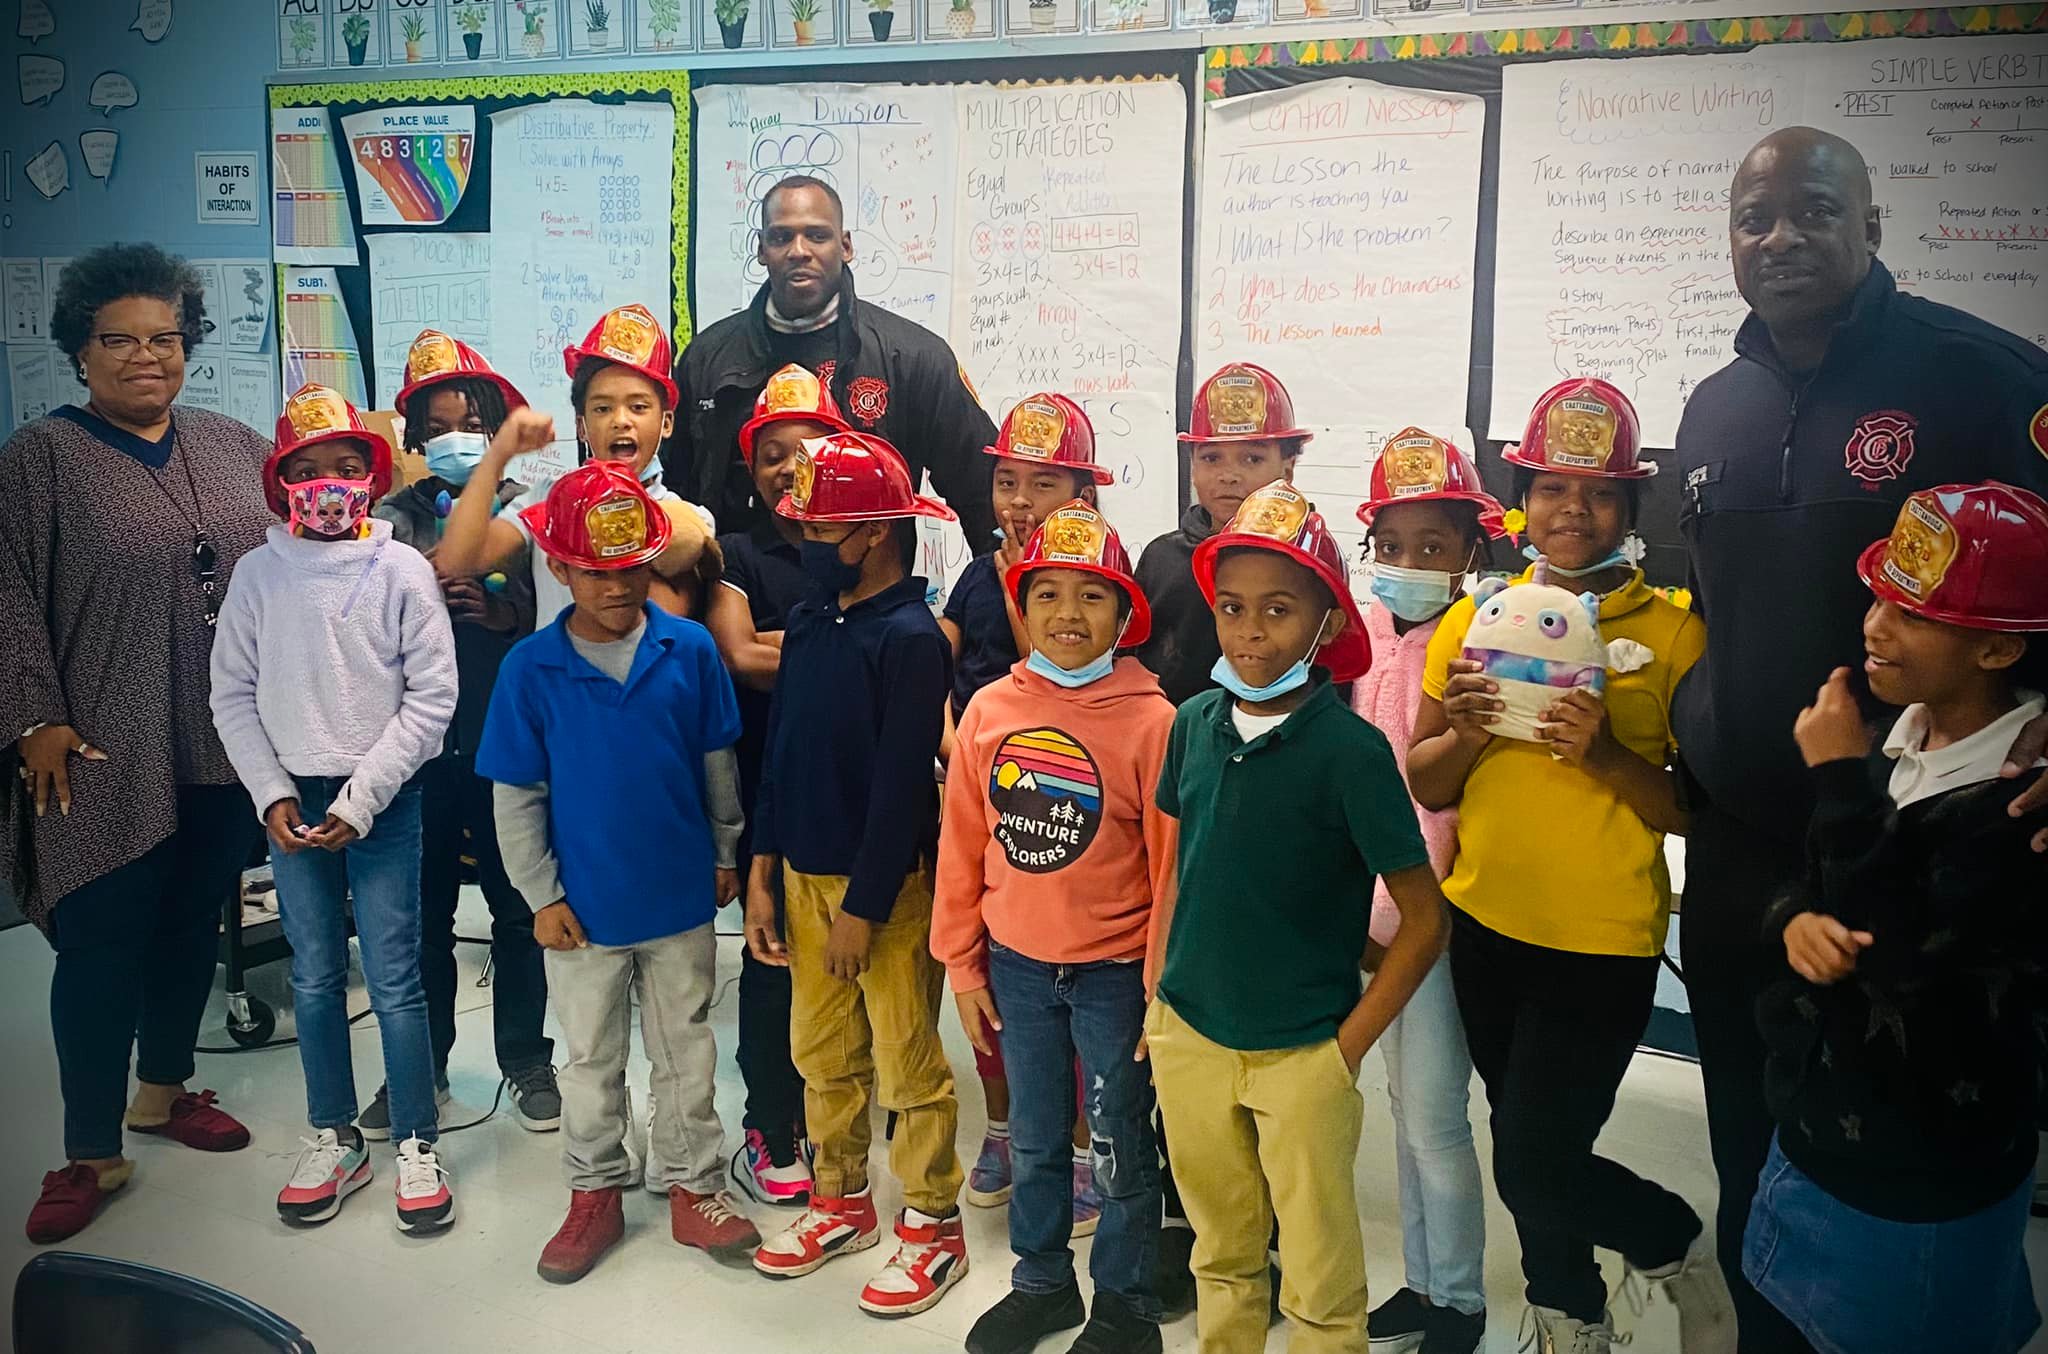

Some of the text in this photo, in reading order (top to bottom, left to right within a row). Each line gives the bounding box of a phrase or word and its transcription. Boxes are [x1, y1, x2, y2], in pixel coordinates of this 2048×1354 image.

[1872, 54, 2028, 84] SIMPLE VERB
[814, 95, 909, 122] Division
[966, 87, 1136, 131] MULTIPLICATION
[1577, 83, 1776, 126] Narrative Writing
[1845, 94, 1896, 113] PAST
[383, 115, 449, 127] PLACE VALUE
[750, 113, 782, 135] Array
[1249, 96, 1465, 139] Central Message
[989, 121, 1114, 160] STRATEGIES
[561, 150, 587, 168] with
[1219, 152, 1414, 187] The Lesson the
[1534, 155, 1566, 184] The
[1647, 159, 1673, 180] of
[1943, 161, 1957, 174] to
[1966, 162, 1998, 174] school
[205, 166, 249, 178] HABITS
[967, 165, 1007, 201] Equal
[219, 183, 235, 195] OF
[1645, 186, 1662, 206] to
[1673, 185, 1701, 206] tell
[1703, 190, 1715, 203] a
[207, 200, 251, 212] INTERACTION
[989, 194, 1042, 220] Groups
[1223, 194, 1281, 215] author
[1231, 224, 1283, 264] What
[1319, 221, 1345, 250] the
[1614, 228, 1635, 242] an
[1916, 268, 1930, 280] to
[1240, 272, 1285, 302] What
[1295, 276, 1340, 302] does
[1353, 271, 1377, 300] the
[1038, 304, 1077, 342] Array
[1242, 323, 1271, 344] The
[1560, 317, 1622, 337] Important
